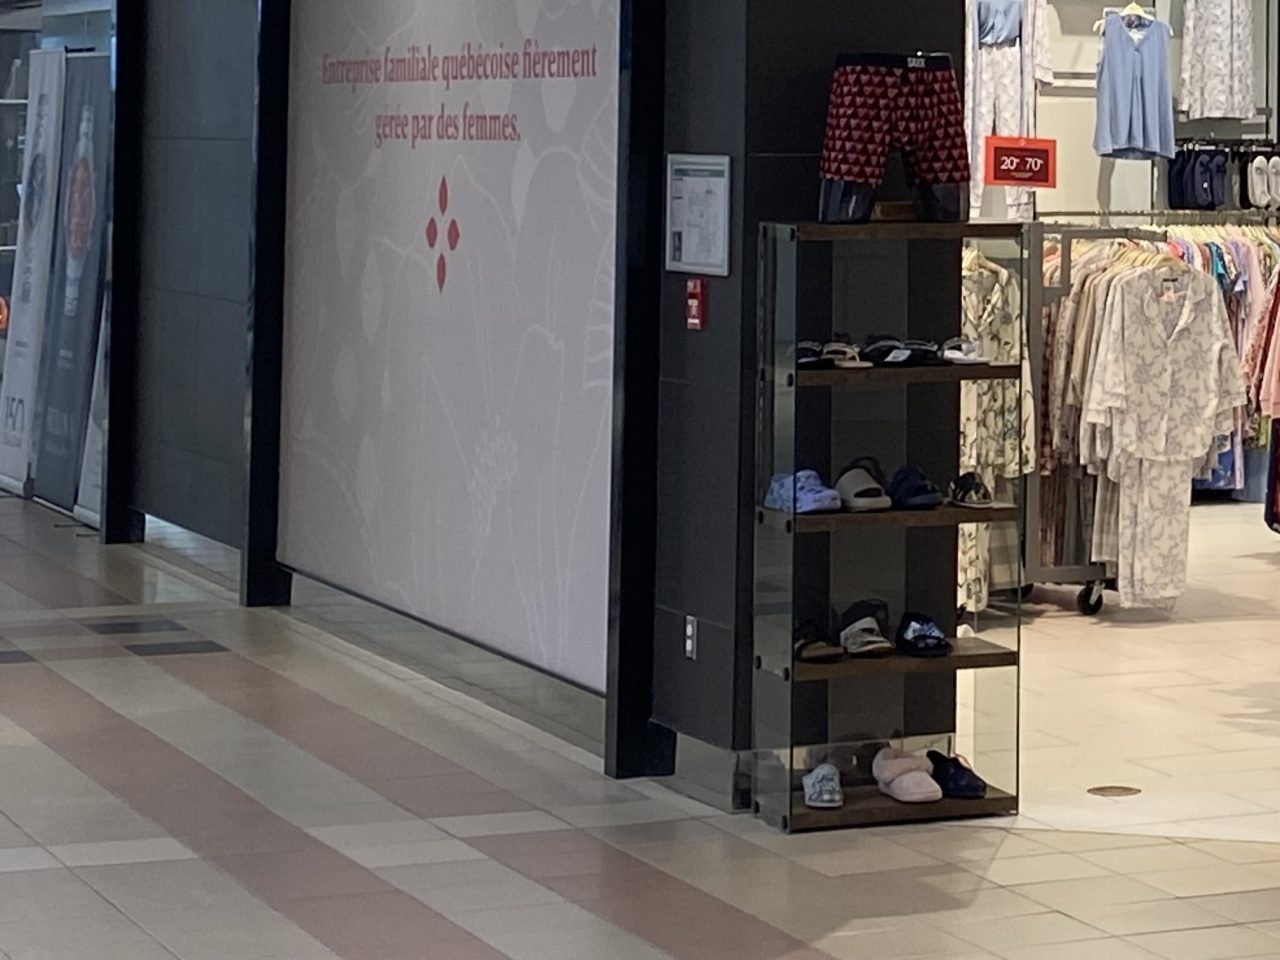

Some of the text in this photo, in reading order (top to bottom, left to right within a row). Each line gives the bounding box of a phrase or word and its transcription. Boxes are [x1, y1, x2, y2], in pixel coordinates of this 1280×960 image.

[322, 38, 597, 93] Entreprise familiale québécoise fièrement
[375, 101, 521, 149] gérée par des femmes.
